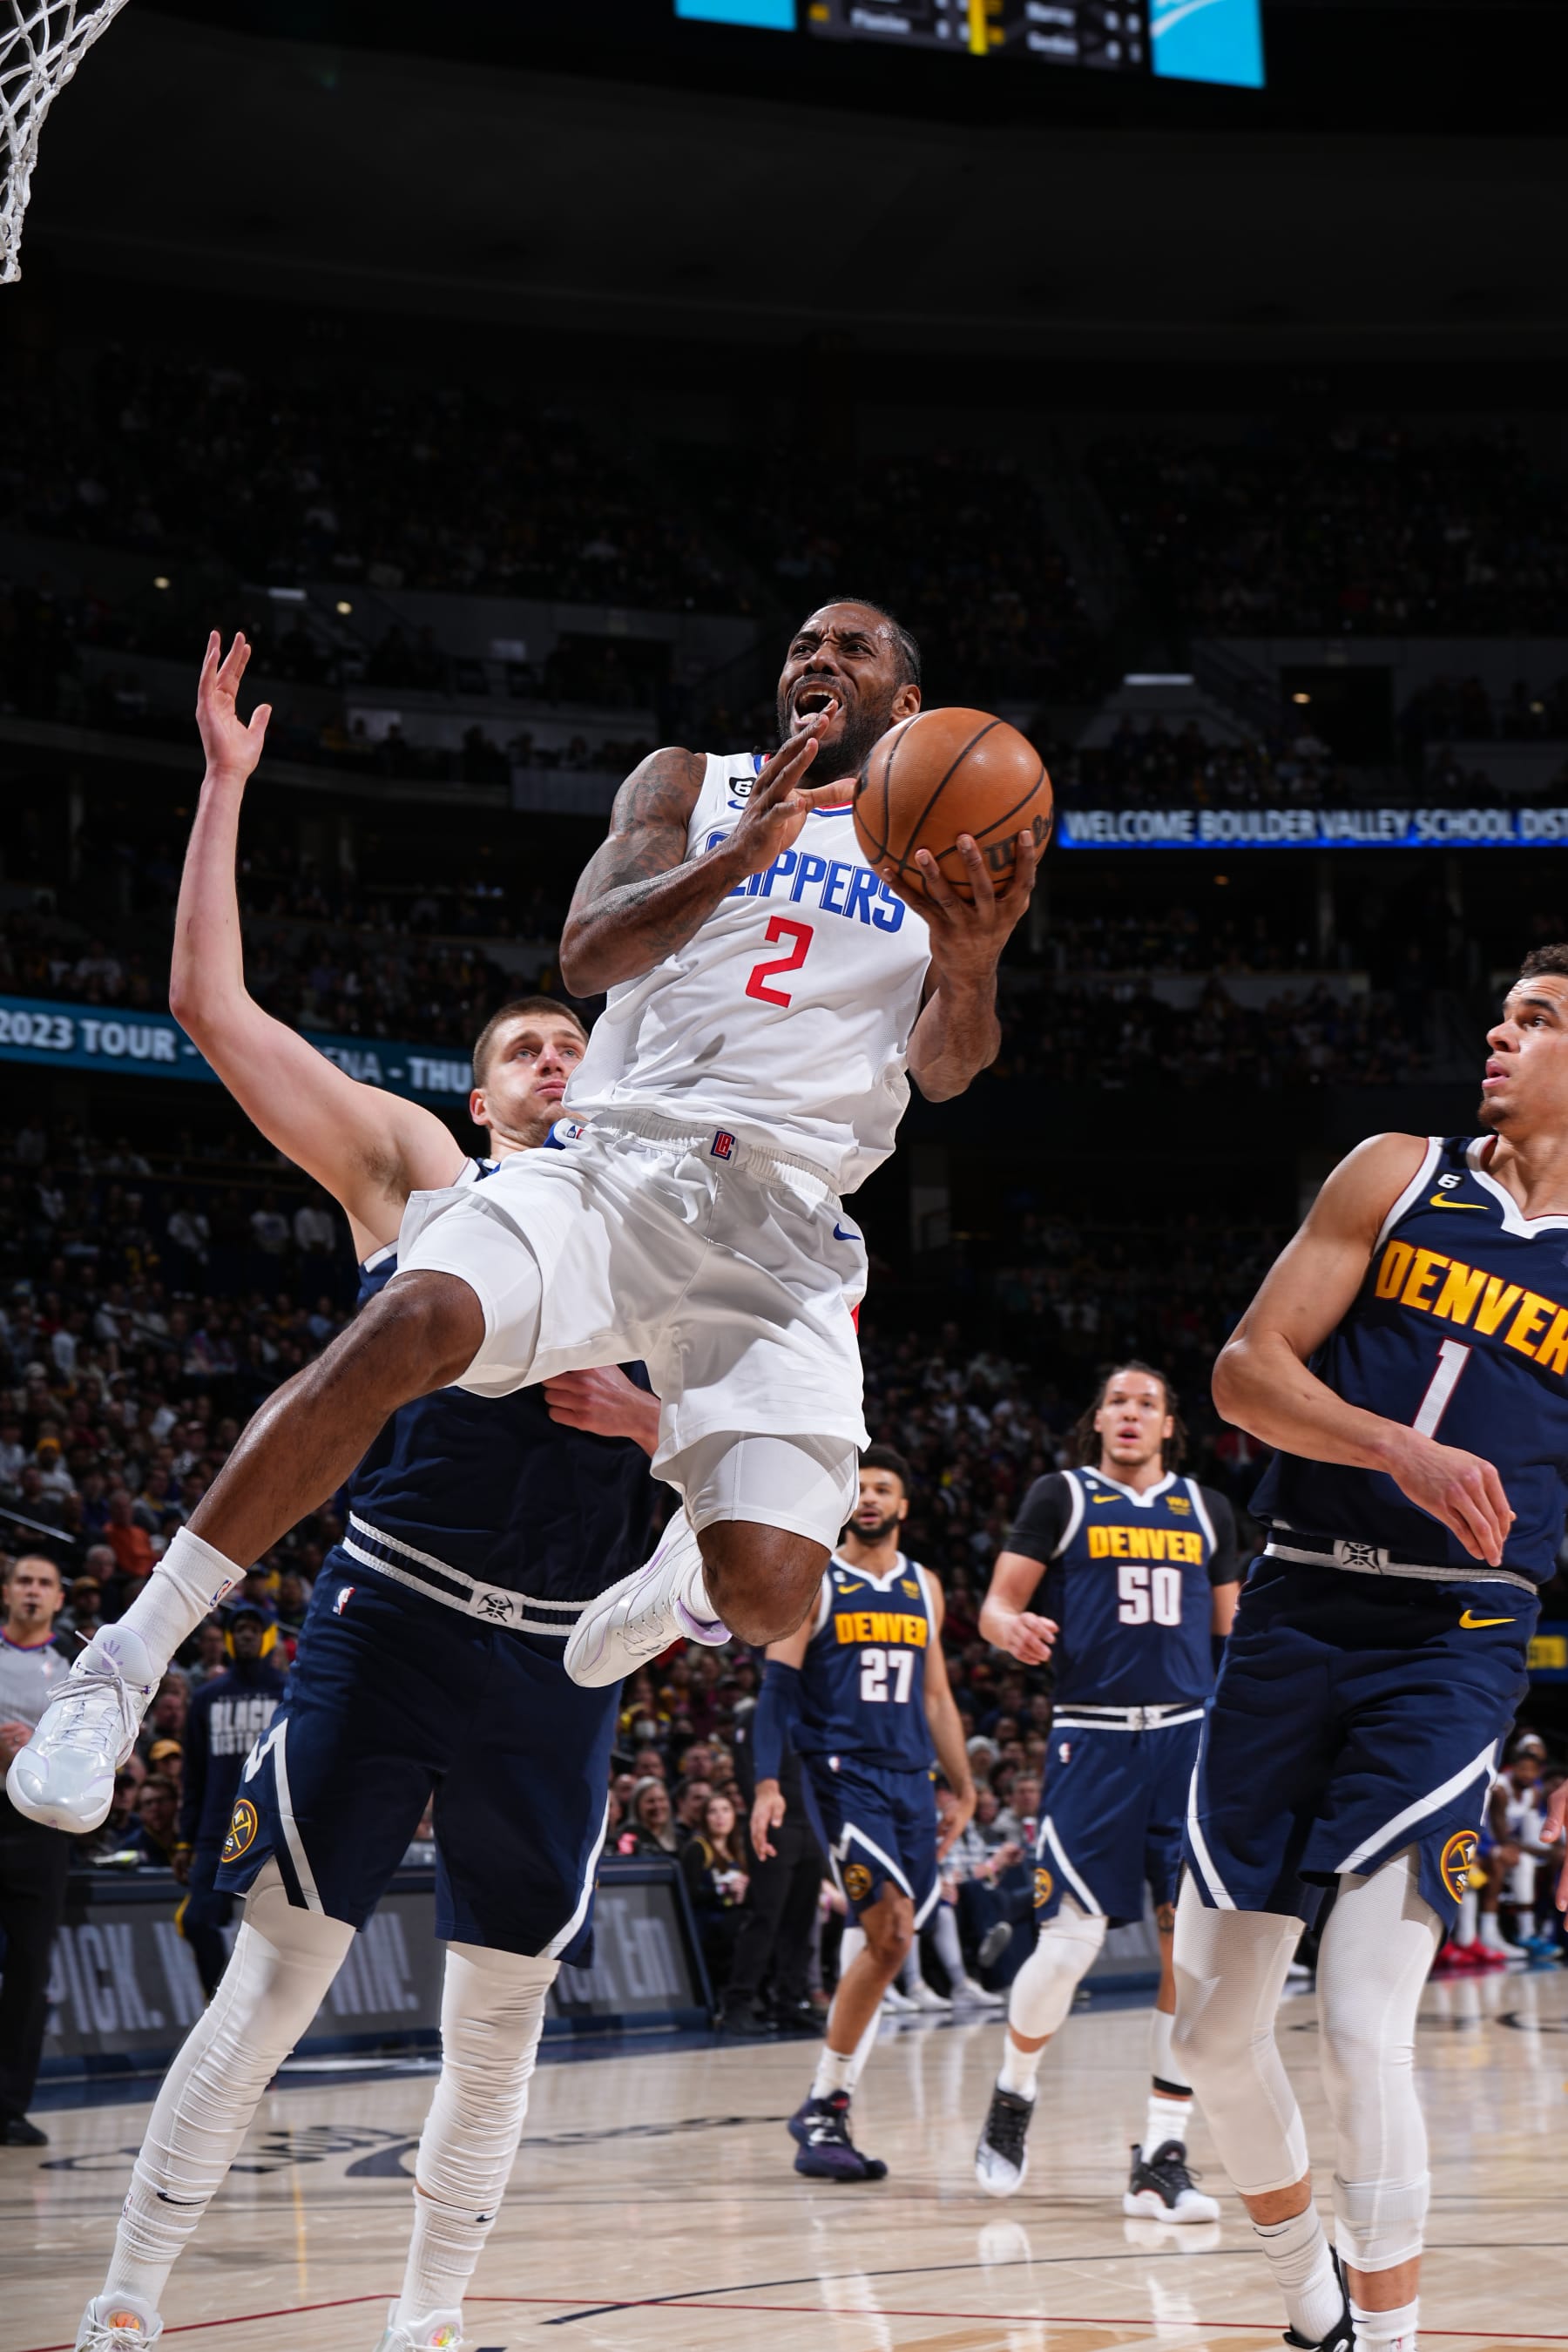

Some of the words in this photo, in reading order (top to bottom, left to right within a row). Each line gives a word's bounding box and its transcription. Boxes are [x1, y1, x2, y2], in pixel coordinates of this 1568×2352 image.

[1064, 810, 1194, 841] WELCOME
[1199, 809, 1318, 841] BOULDER
[1319, 808, 1412, 841] VALLEY
[1414, 808, 1517, 841] SCHOOL
[705, 831, 906, 934] IPPERS
[745, 916, 814, 1008] 2
[0, 1009, 74, 1050] 2023
[79, 1019, 177, 1061] TOUR
[1437, 1173, 1462, 1190] 6
[1411, 1336, 1473, 1439] 1
[1087, 1525, 1203, 1566] DENVER
[1118, 1565, 1181, 1626] 50
[834, 1612, 928, 1647] DENVER
[861, 1648, 915, 1703] 27
[211, 1732, 260, 1756] HISTO
